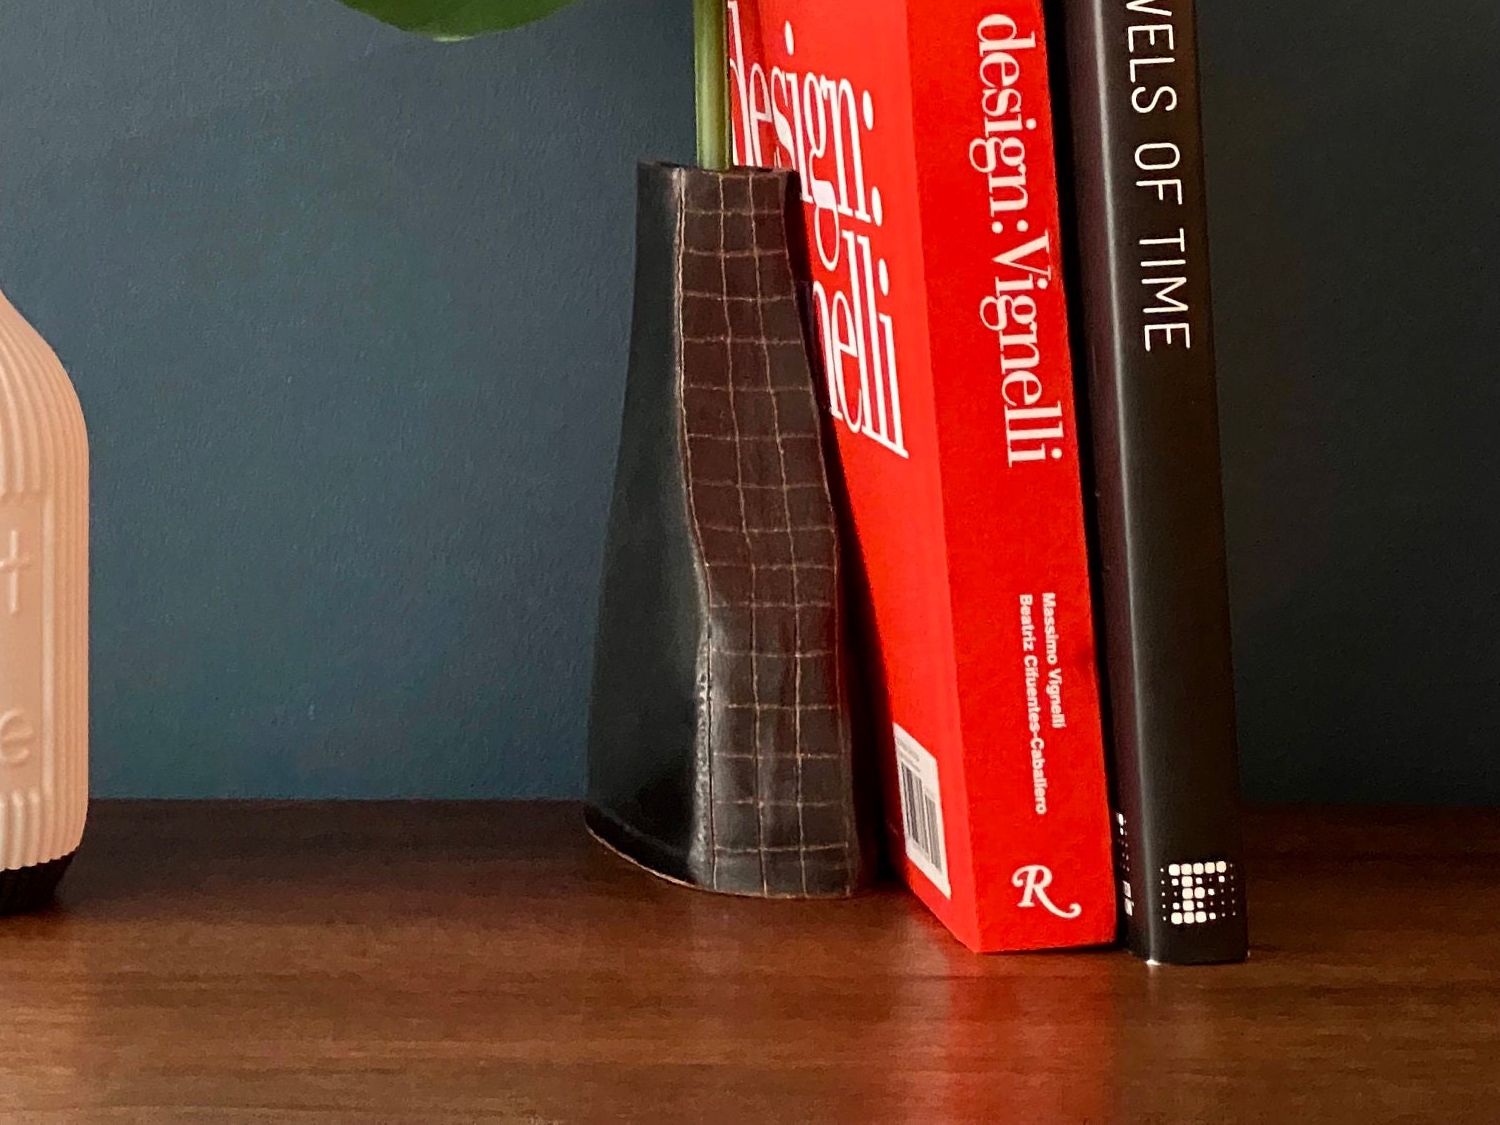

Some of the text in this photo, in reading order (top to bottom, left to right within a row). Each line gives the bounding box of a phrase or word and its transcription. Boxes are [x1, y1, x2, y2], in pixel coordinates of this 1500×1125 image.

[1134, 142, 1183, 206] OF
[968, 13, 1064, 468] design: Vignelli
[1138, 227, 1191, 352] TIME
[1019, 594, 1049, 815] Beatriz Cifuentes-Caballero
[1041, 592, 1067, 729] Massimo Vignelli
[1011, 864, 1082, 919] R
